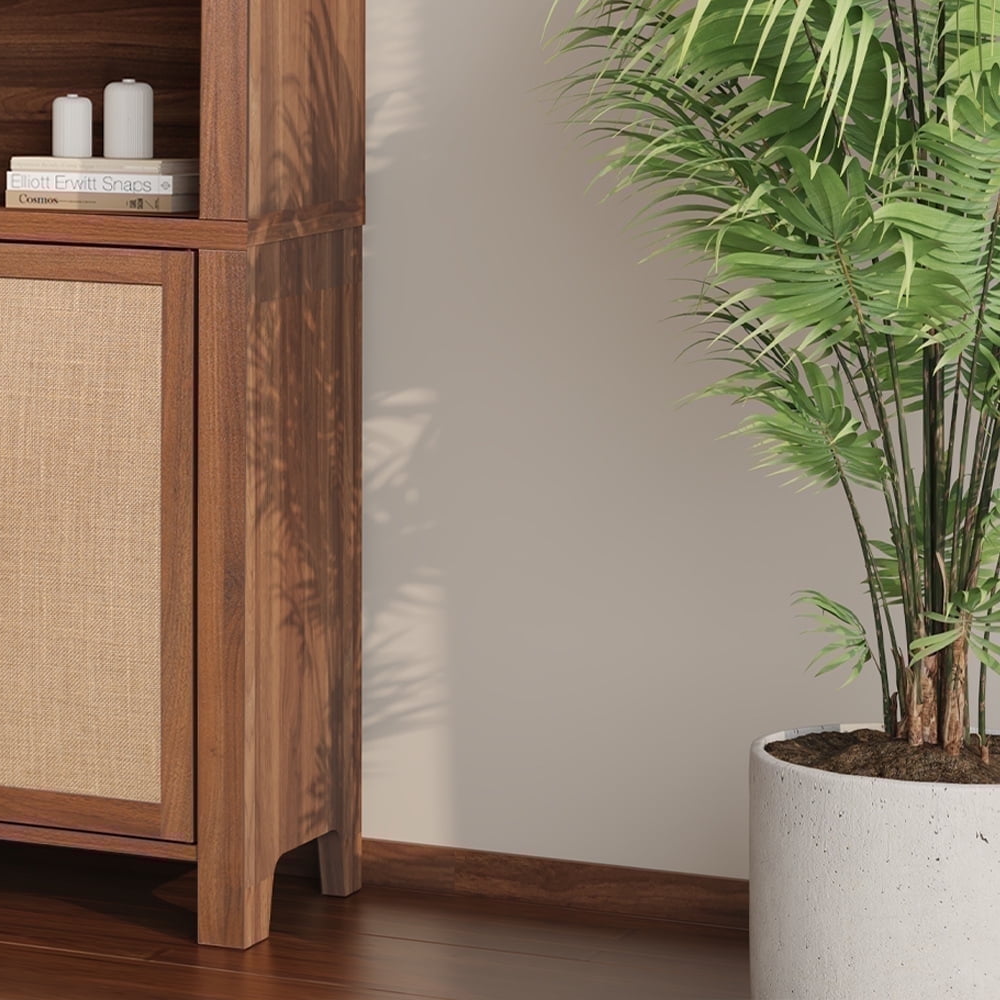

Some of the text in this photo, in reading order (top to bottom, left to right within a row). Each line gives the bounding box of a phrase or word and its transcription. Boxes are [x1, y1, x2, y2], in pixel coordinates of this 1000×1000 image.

[10, 174, 152, 193] Elliott Erwitt Snaps
[18, 193, 59, 205] Cosmos
